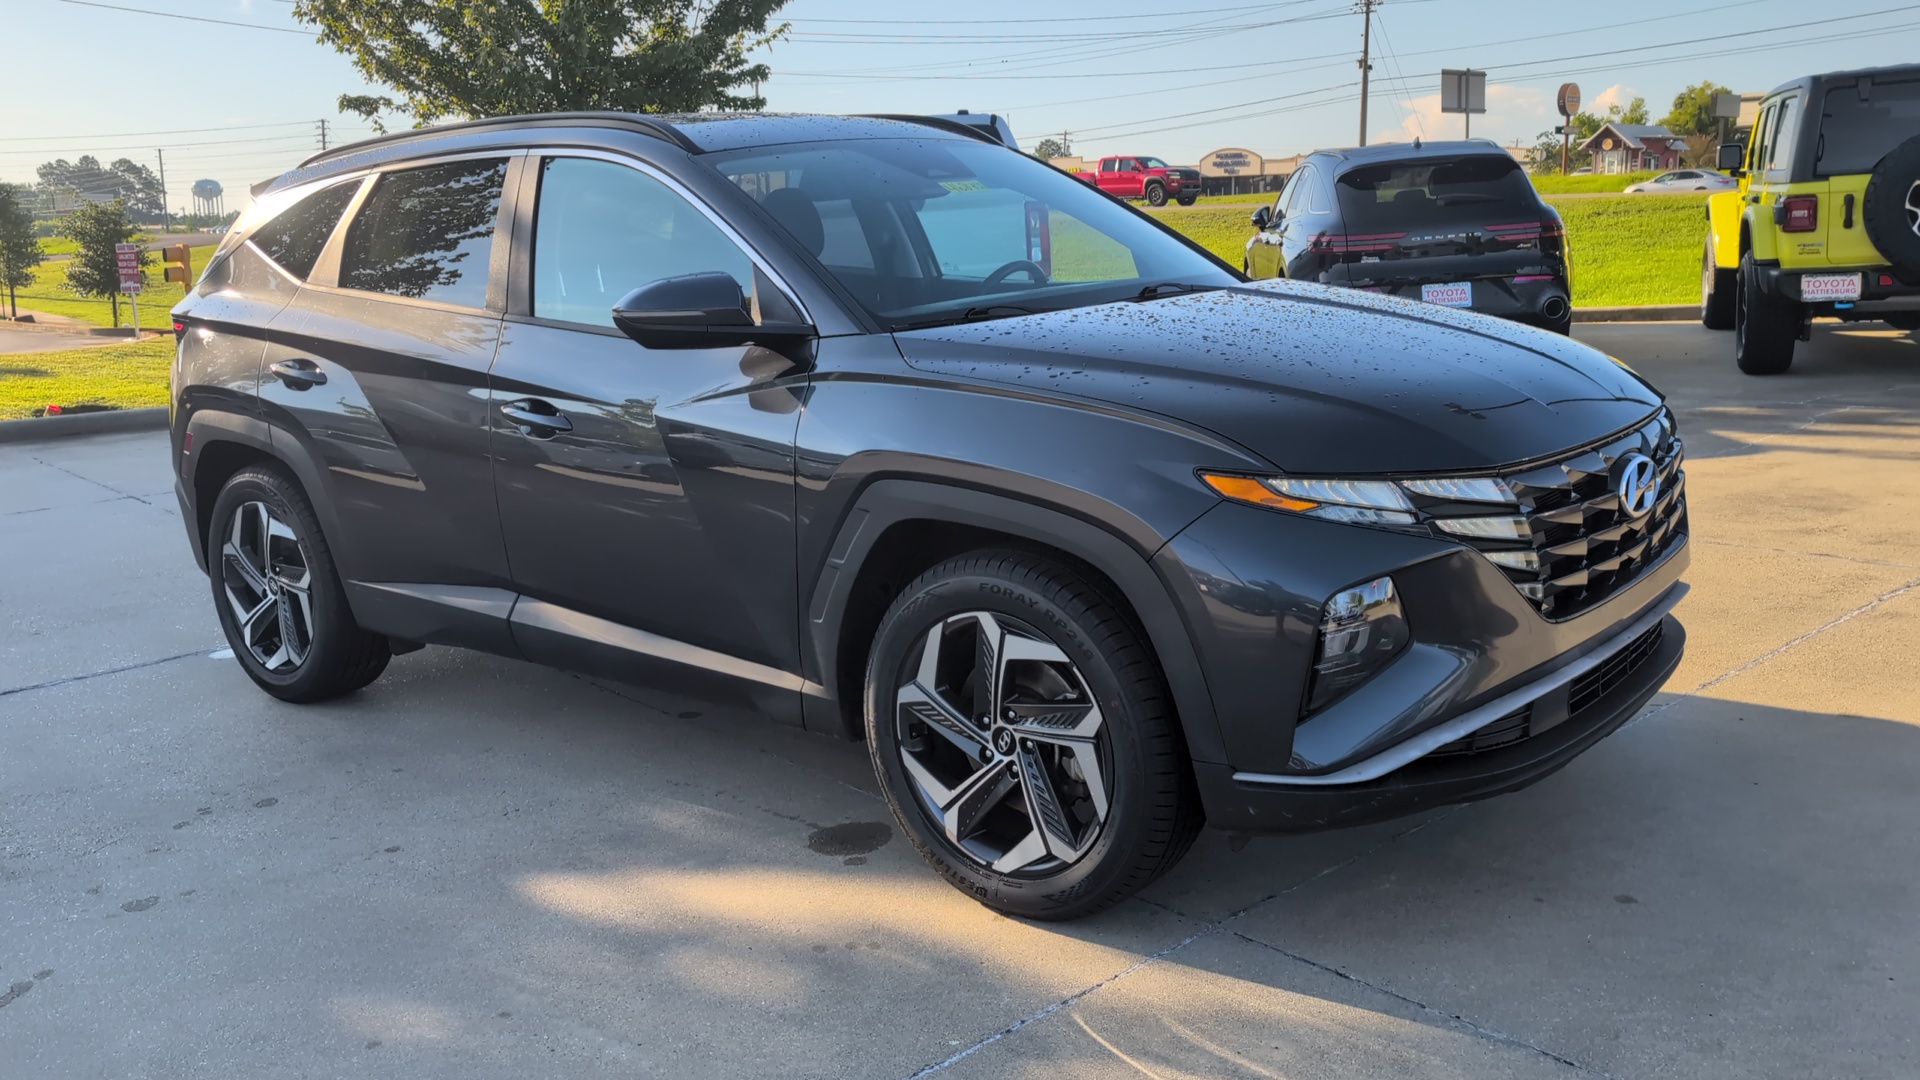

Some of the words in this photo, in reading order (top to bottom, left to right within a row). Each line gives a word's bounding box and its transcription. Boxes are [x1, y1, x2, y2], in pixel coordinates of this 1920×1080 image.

[1805, 279, 1856, 289] TOYOTA
[1425, 288, 1467, 298] TOYOTA
[979, 582, 1039, 608] FORAY
